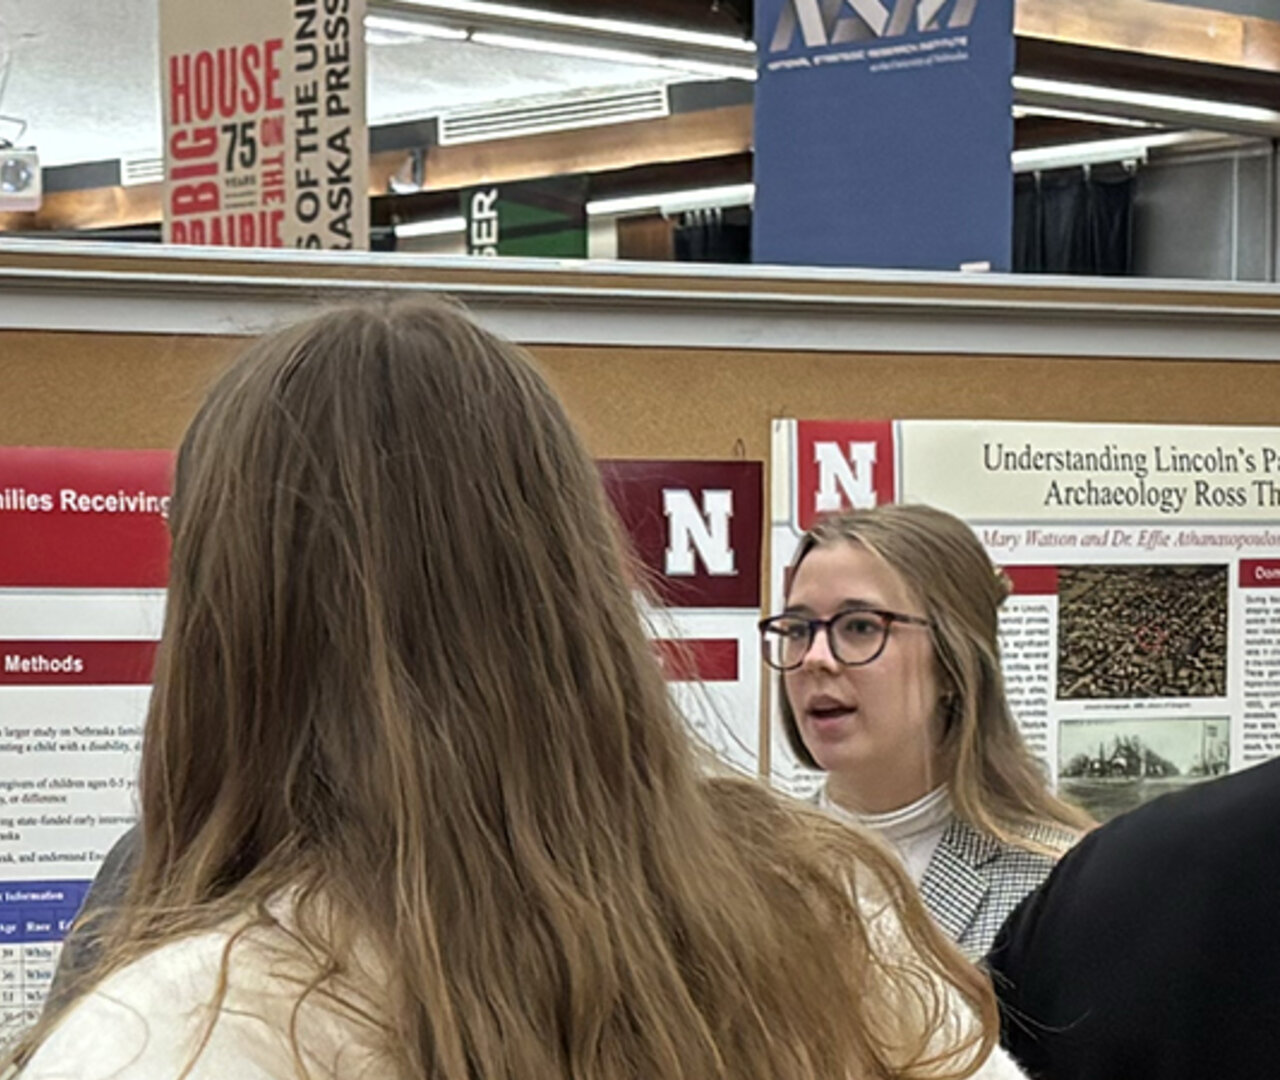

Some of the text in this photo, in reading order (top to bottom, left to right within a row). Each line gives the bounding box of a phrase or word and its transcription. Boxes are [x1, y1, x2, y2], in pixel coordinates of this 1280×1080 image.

[170, 38, 285, 125] HOUSE
[222, 121, 256, 172] 75
[295, 81, 318, 162] THE
[170, 126, 220, 216] BIG
[262, 153, 285, 206] THE
[296, 169, 320, 223] OF
[813, 441, 878, 512] N
[984, 444, 1148, 479] Understanding
[1044, 478, 1247, 513] Archaeology Ross
[664, 488, 738, 576] N
[1026, 530, 1077, 547] Watson
[1080, 530, 1110, 547] and
[1111, 530, 1132, 547] Dr.
[1137, 530, 1171, 551] Effie
[4, 655, 83, 672] Methods
